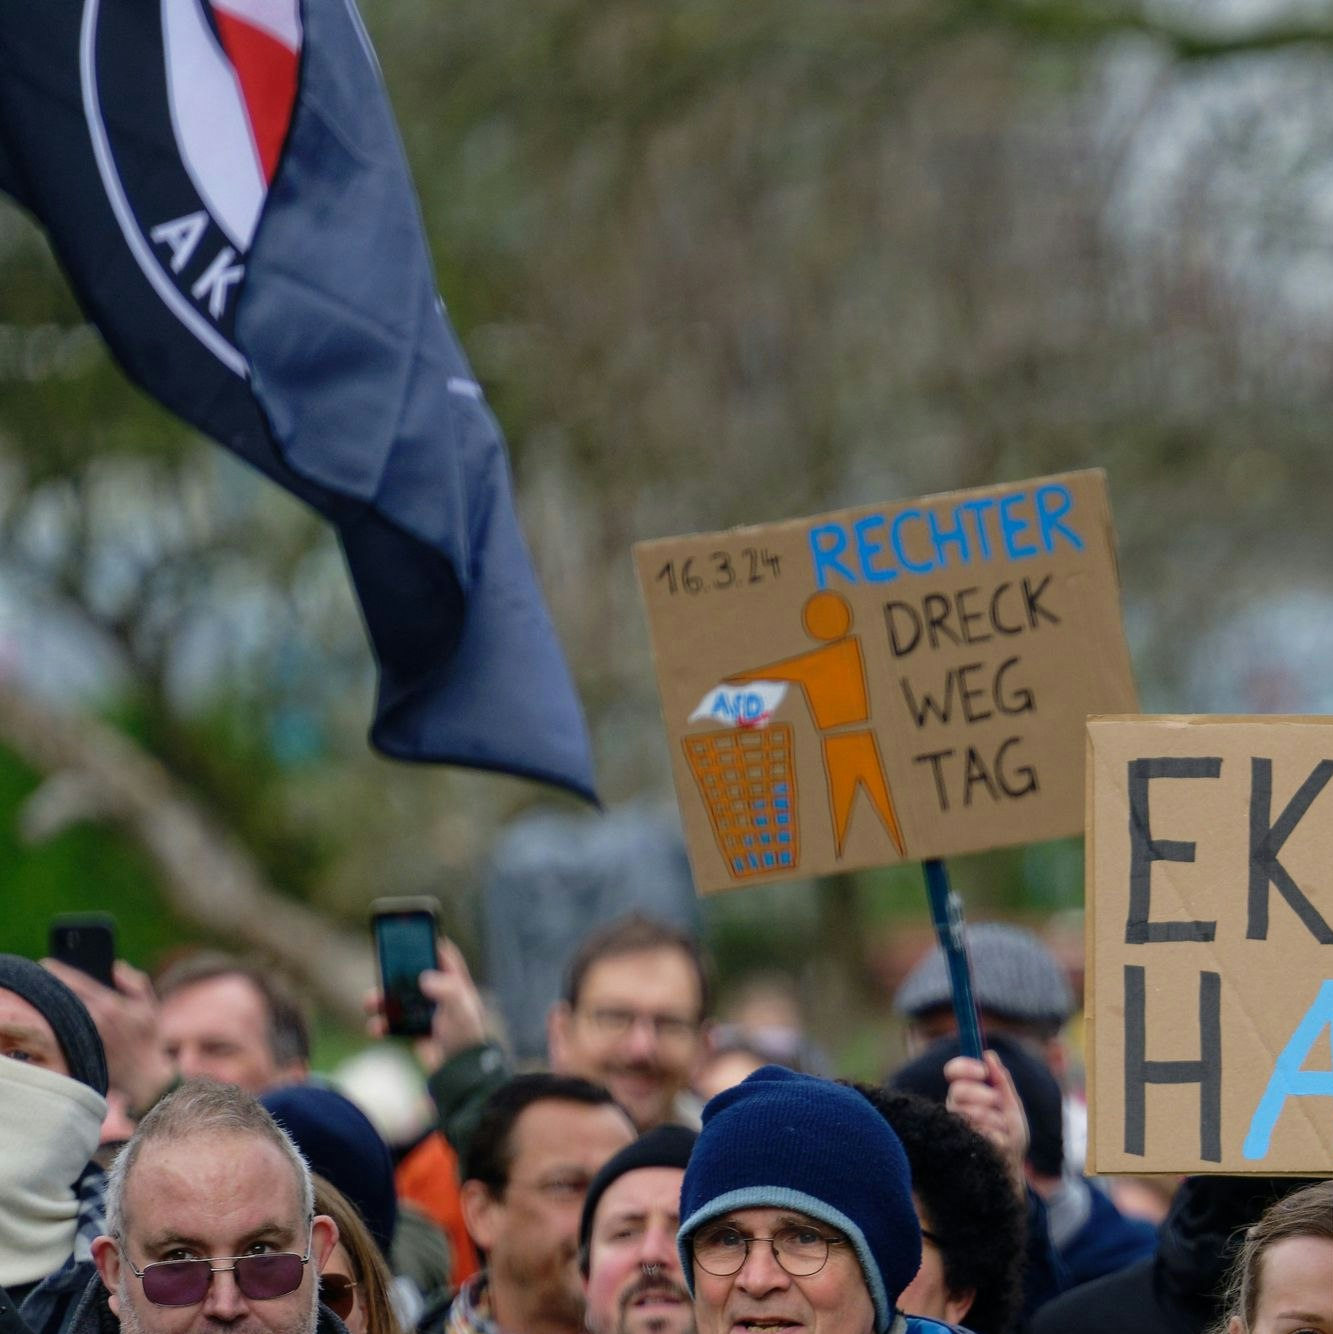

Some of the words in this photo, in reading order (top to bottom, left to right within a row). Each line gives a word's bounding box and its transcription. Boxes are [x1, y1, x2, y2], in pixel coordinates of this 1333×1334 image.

[656, 547, 782, 595] 16.3.24
[807, 483, 1084, 591] RECHTER
[883, 574, 1062, 658] DRECK
[899, 655, 1036, 730] WEG
[913, 736, 1041, 813] TAG
